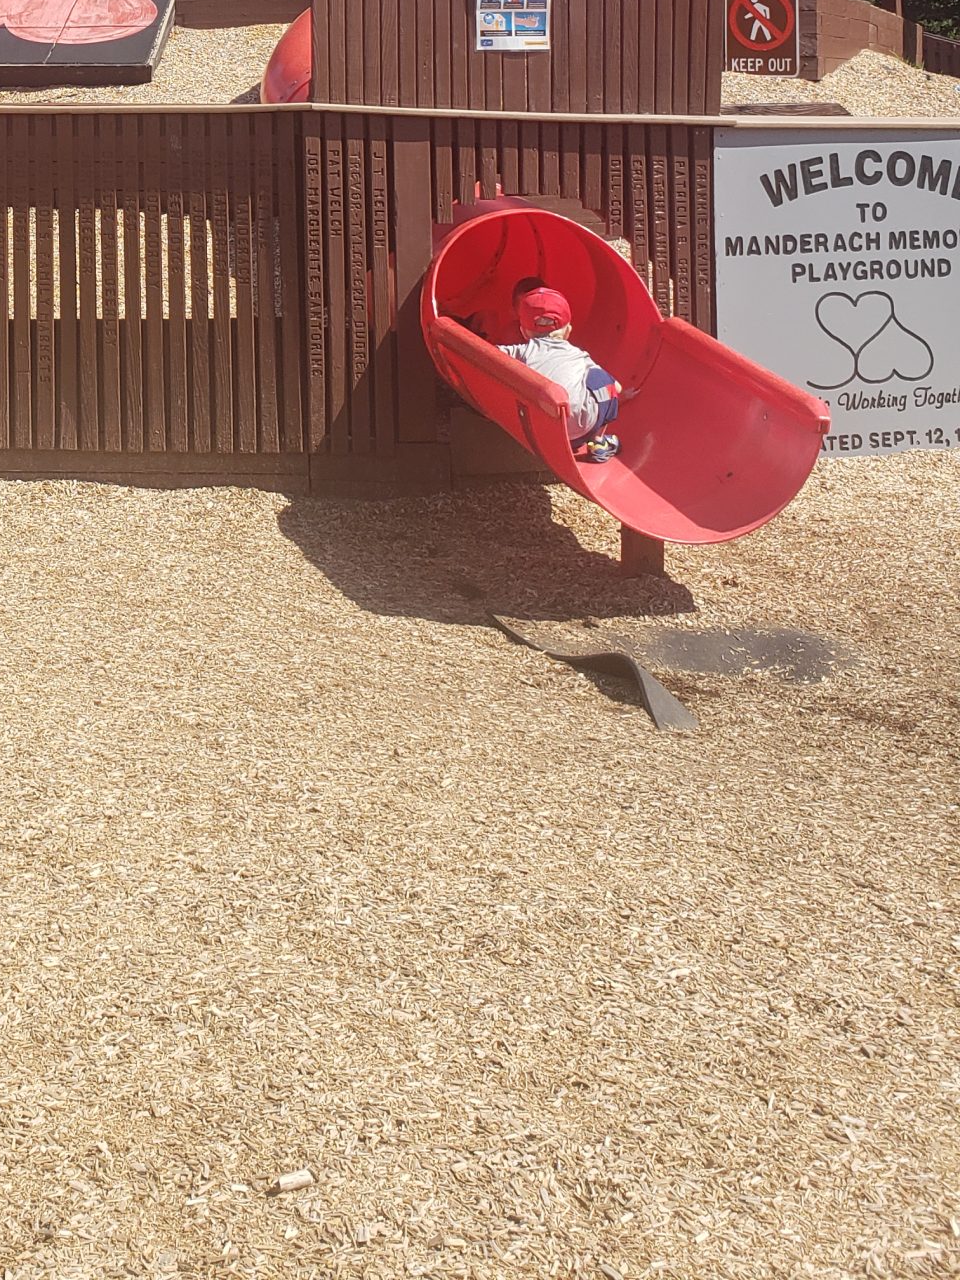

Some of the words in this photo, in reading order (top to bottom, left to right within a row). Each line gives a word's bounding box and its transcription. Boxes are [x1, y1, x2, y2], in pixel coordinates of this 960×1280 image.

[731, 57, 764, 72] KEEP
[768, 57, 792, 72] OUT
[328, 150, 341, 177] PAT
[675, 161, 688, 228] PATRICIA
[329, 187, 343, 238] WELCH
[855, 202, 887, 223] TO
[725, 231, 881, 257] MANDERACH
[889, 229, 960, 251] MEMO
[792, 258, 952, 283] PLAYGROUND
[837, 390, 907, 412] Working
[913, 386, 960, 409] Toget
[869, 430, 921, 449] SEPT.
[925, 428, 951, 447] 12,
